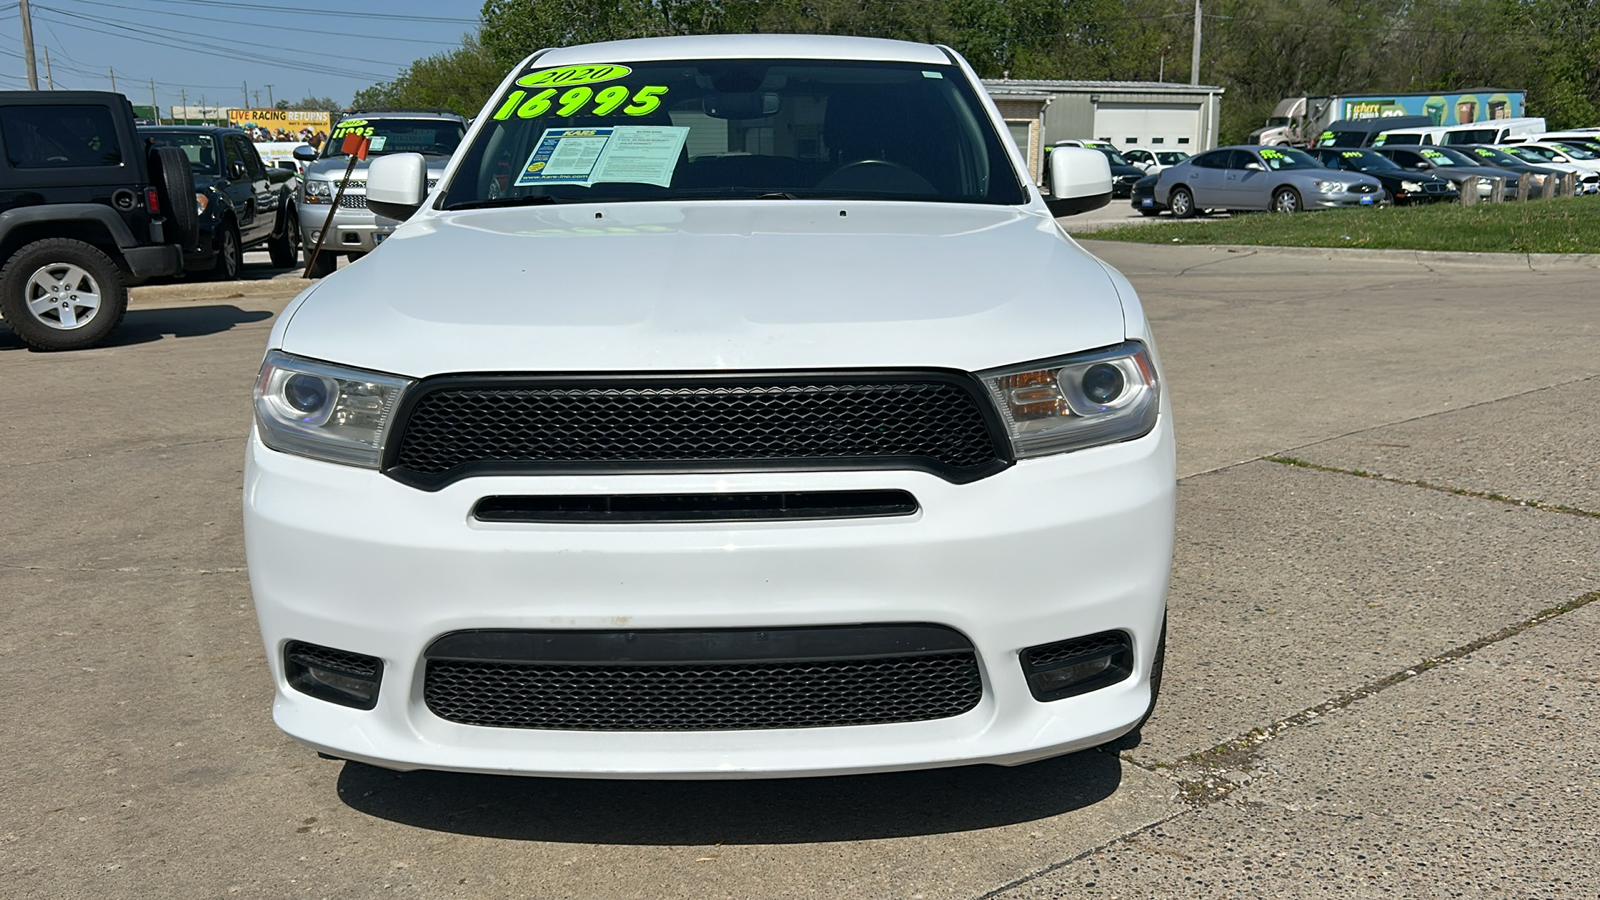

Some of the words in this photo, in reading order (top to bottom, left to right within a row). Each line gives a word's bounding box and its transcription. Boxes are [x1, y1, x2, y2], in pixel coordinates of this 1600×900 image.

[532, 67, 614, 85] 2020
[493, 85, 669, 121] 16995
[1353, 103, 1380, 113] where
[230, 111, 250, 120] LIVE
[252, 111, 286, 121] RACING
[288, 111, 328, 121] RETURNS
